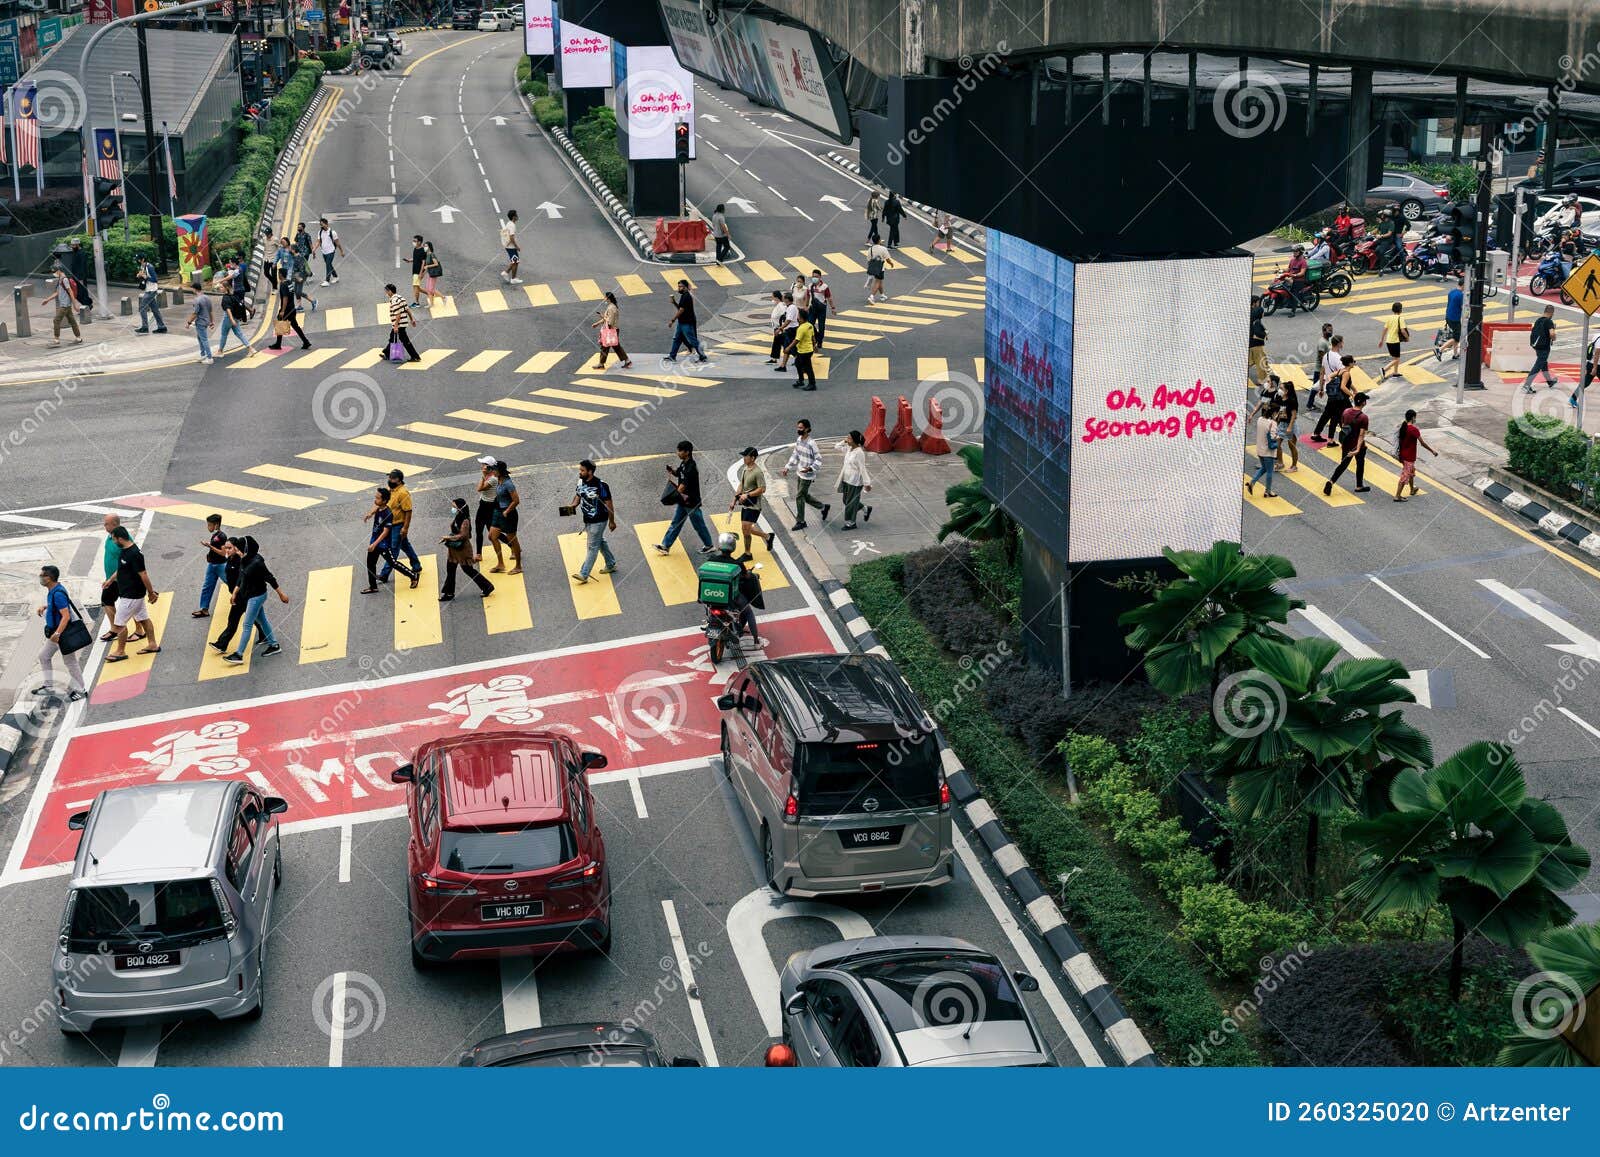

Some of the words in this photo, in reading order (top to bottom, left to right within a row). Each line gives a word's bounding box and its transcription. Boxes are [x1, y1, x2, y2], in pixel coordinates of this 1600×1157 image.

[583, 36, 602, 45] Anda
[563, 46, 592, 54] Seorang
[593, 44, 609, 54] Pro?
[658, 91, 683, 103] Anda
[631, 104, 670, 115] Seorang
[671, 102, 691, 114] Pro?
[1106, 387, 1147, 412] Oh,
[1152, 378, 1215, 411] Anda
[1082, 416, 1181, 444] Seorang
[1185, 410, 1238, 440] Pro?
[703, 588, 725, 598] Grab
[495, 906, 512, 917] VHC
[512, 904, 530, 915] 1817
[146, 953, 169, 965] 4922
